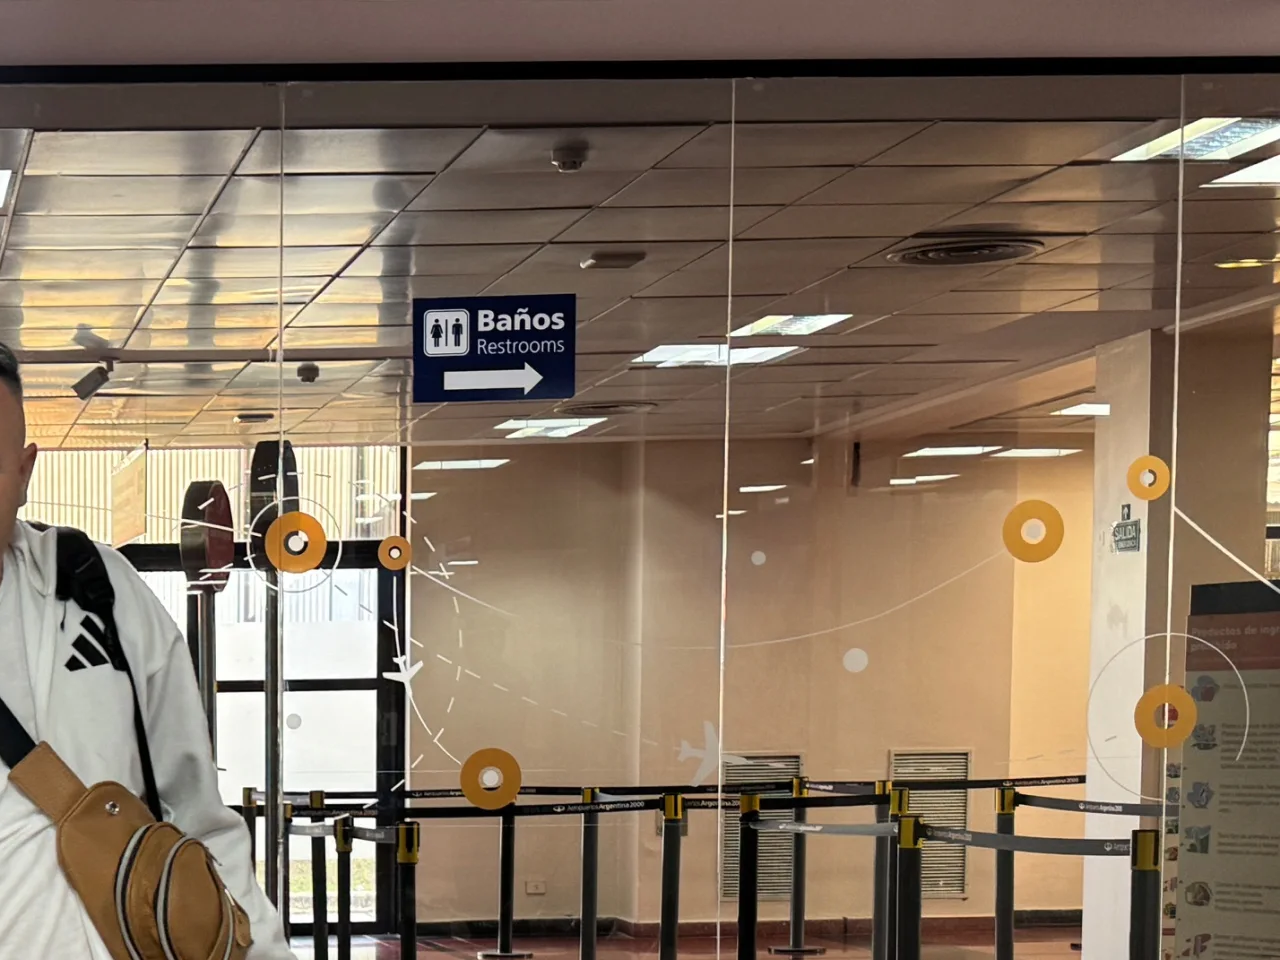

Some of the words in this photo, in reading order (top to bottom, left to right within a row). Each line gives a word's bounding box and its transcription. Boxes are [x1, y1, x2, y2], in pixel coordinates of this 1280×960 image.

[477, 307, 565, 332] Baños
[477, 338, 565, 354] Restrooms
[1244, 625, 1257, 635] de
[599, 802, 630, 811] Argentina
